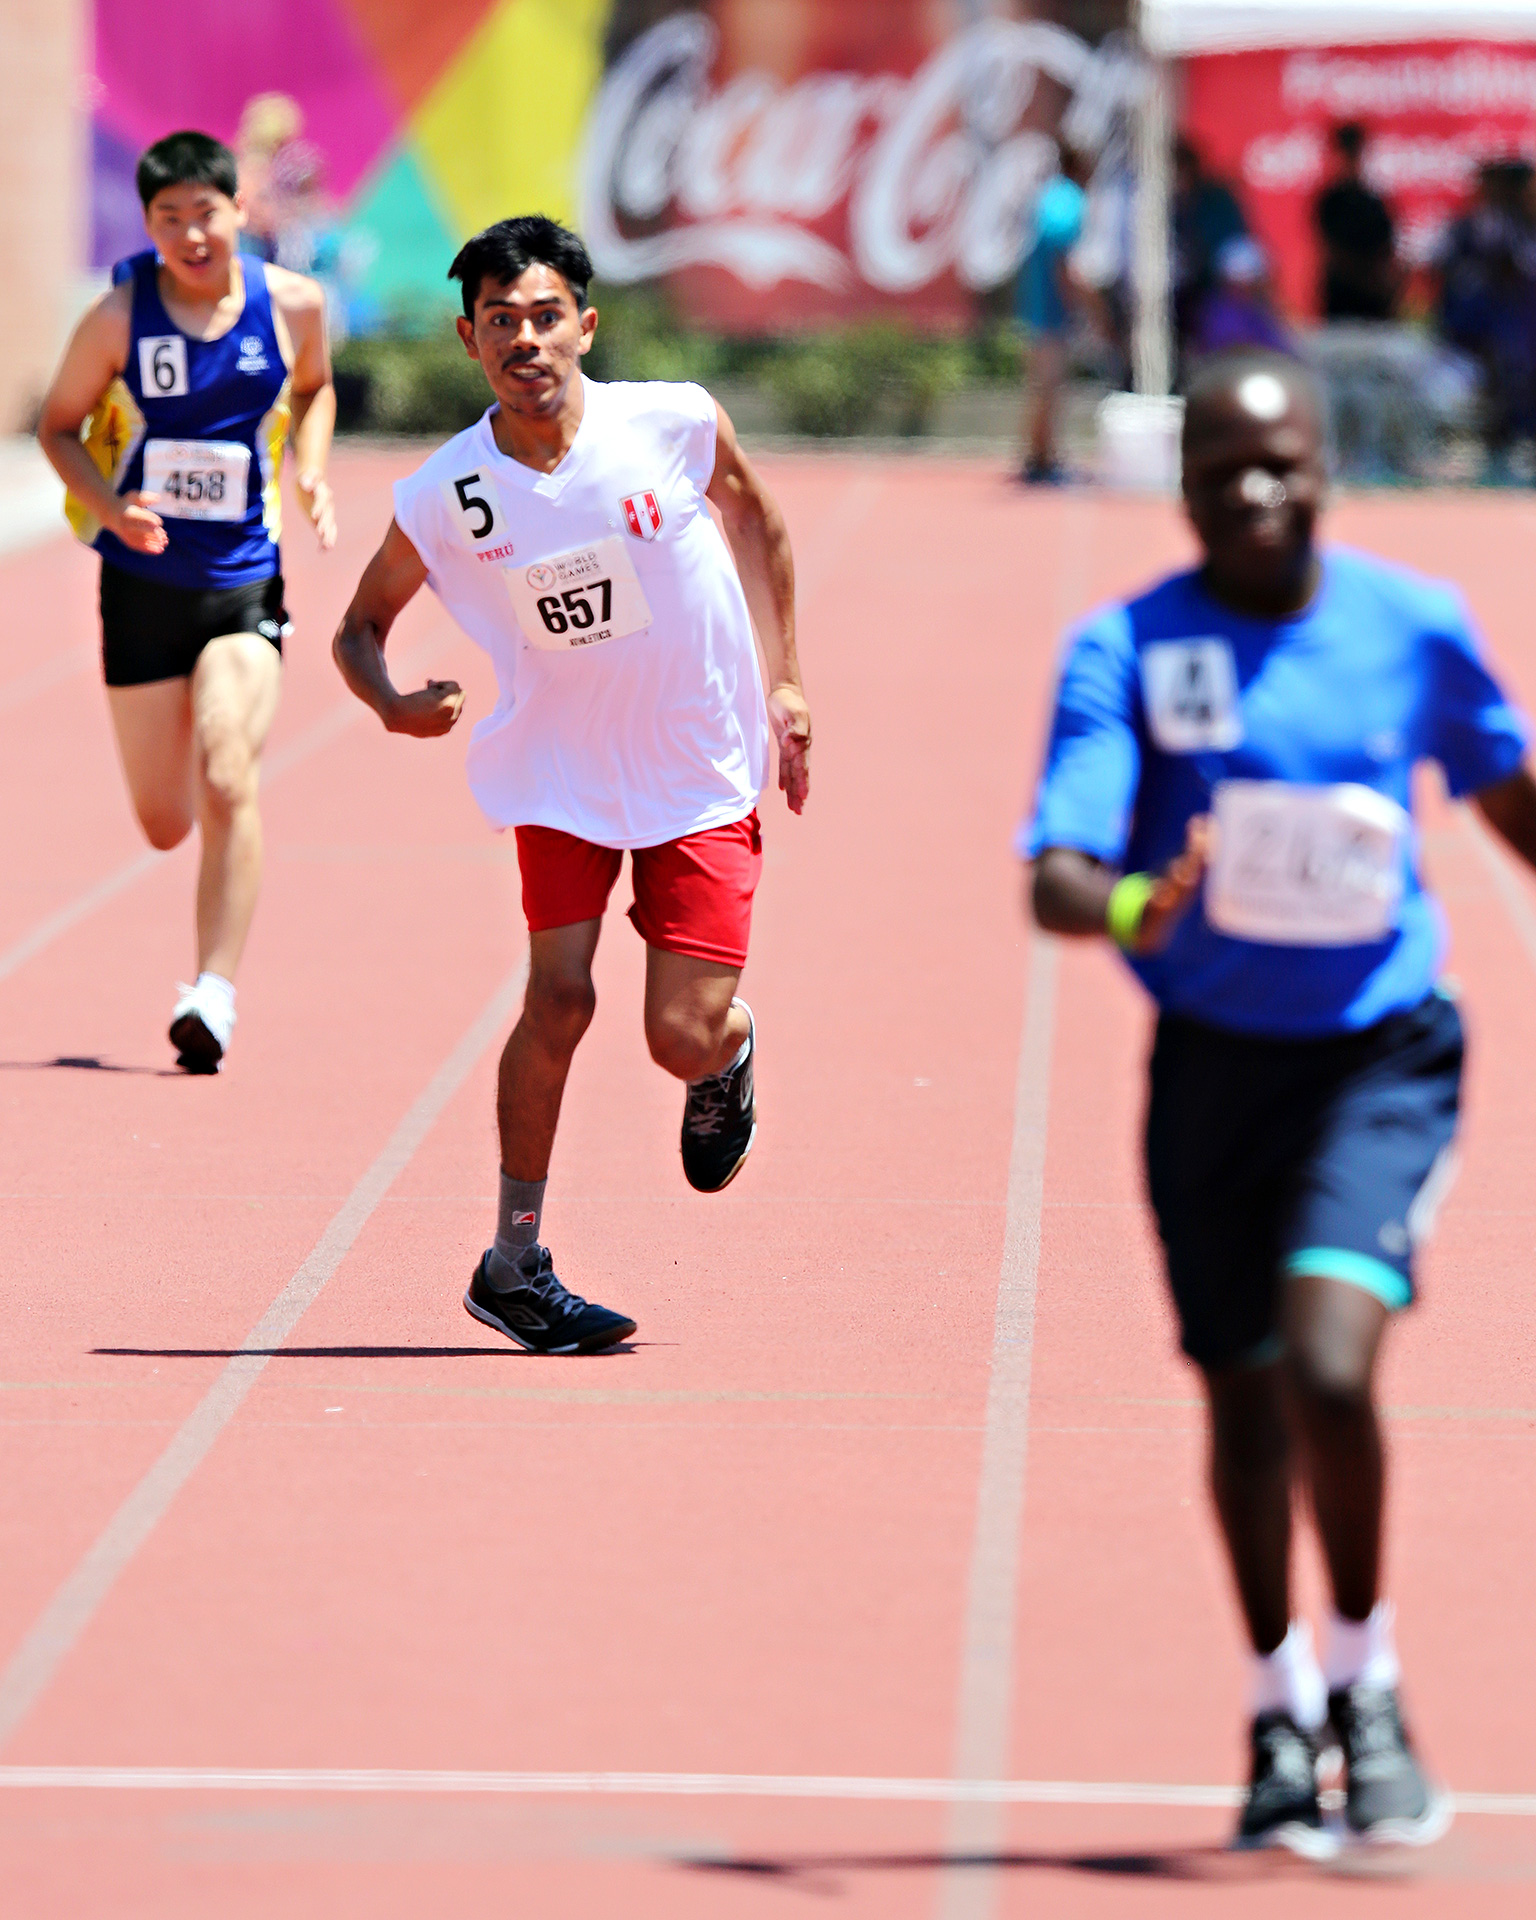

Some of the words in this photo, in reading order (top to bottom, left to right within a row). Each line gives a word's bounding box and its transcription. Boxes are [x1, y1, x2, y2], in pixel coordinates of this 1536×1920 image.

[153, 343, 176, 390] 6
[163, 469, 226, 502] 458
[454, 474, 494, 539] 5
[558, 560, 600, 580] GAMES
[536, 578, 612, 634] 657
